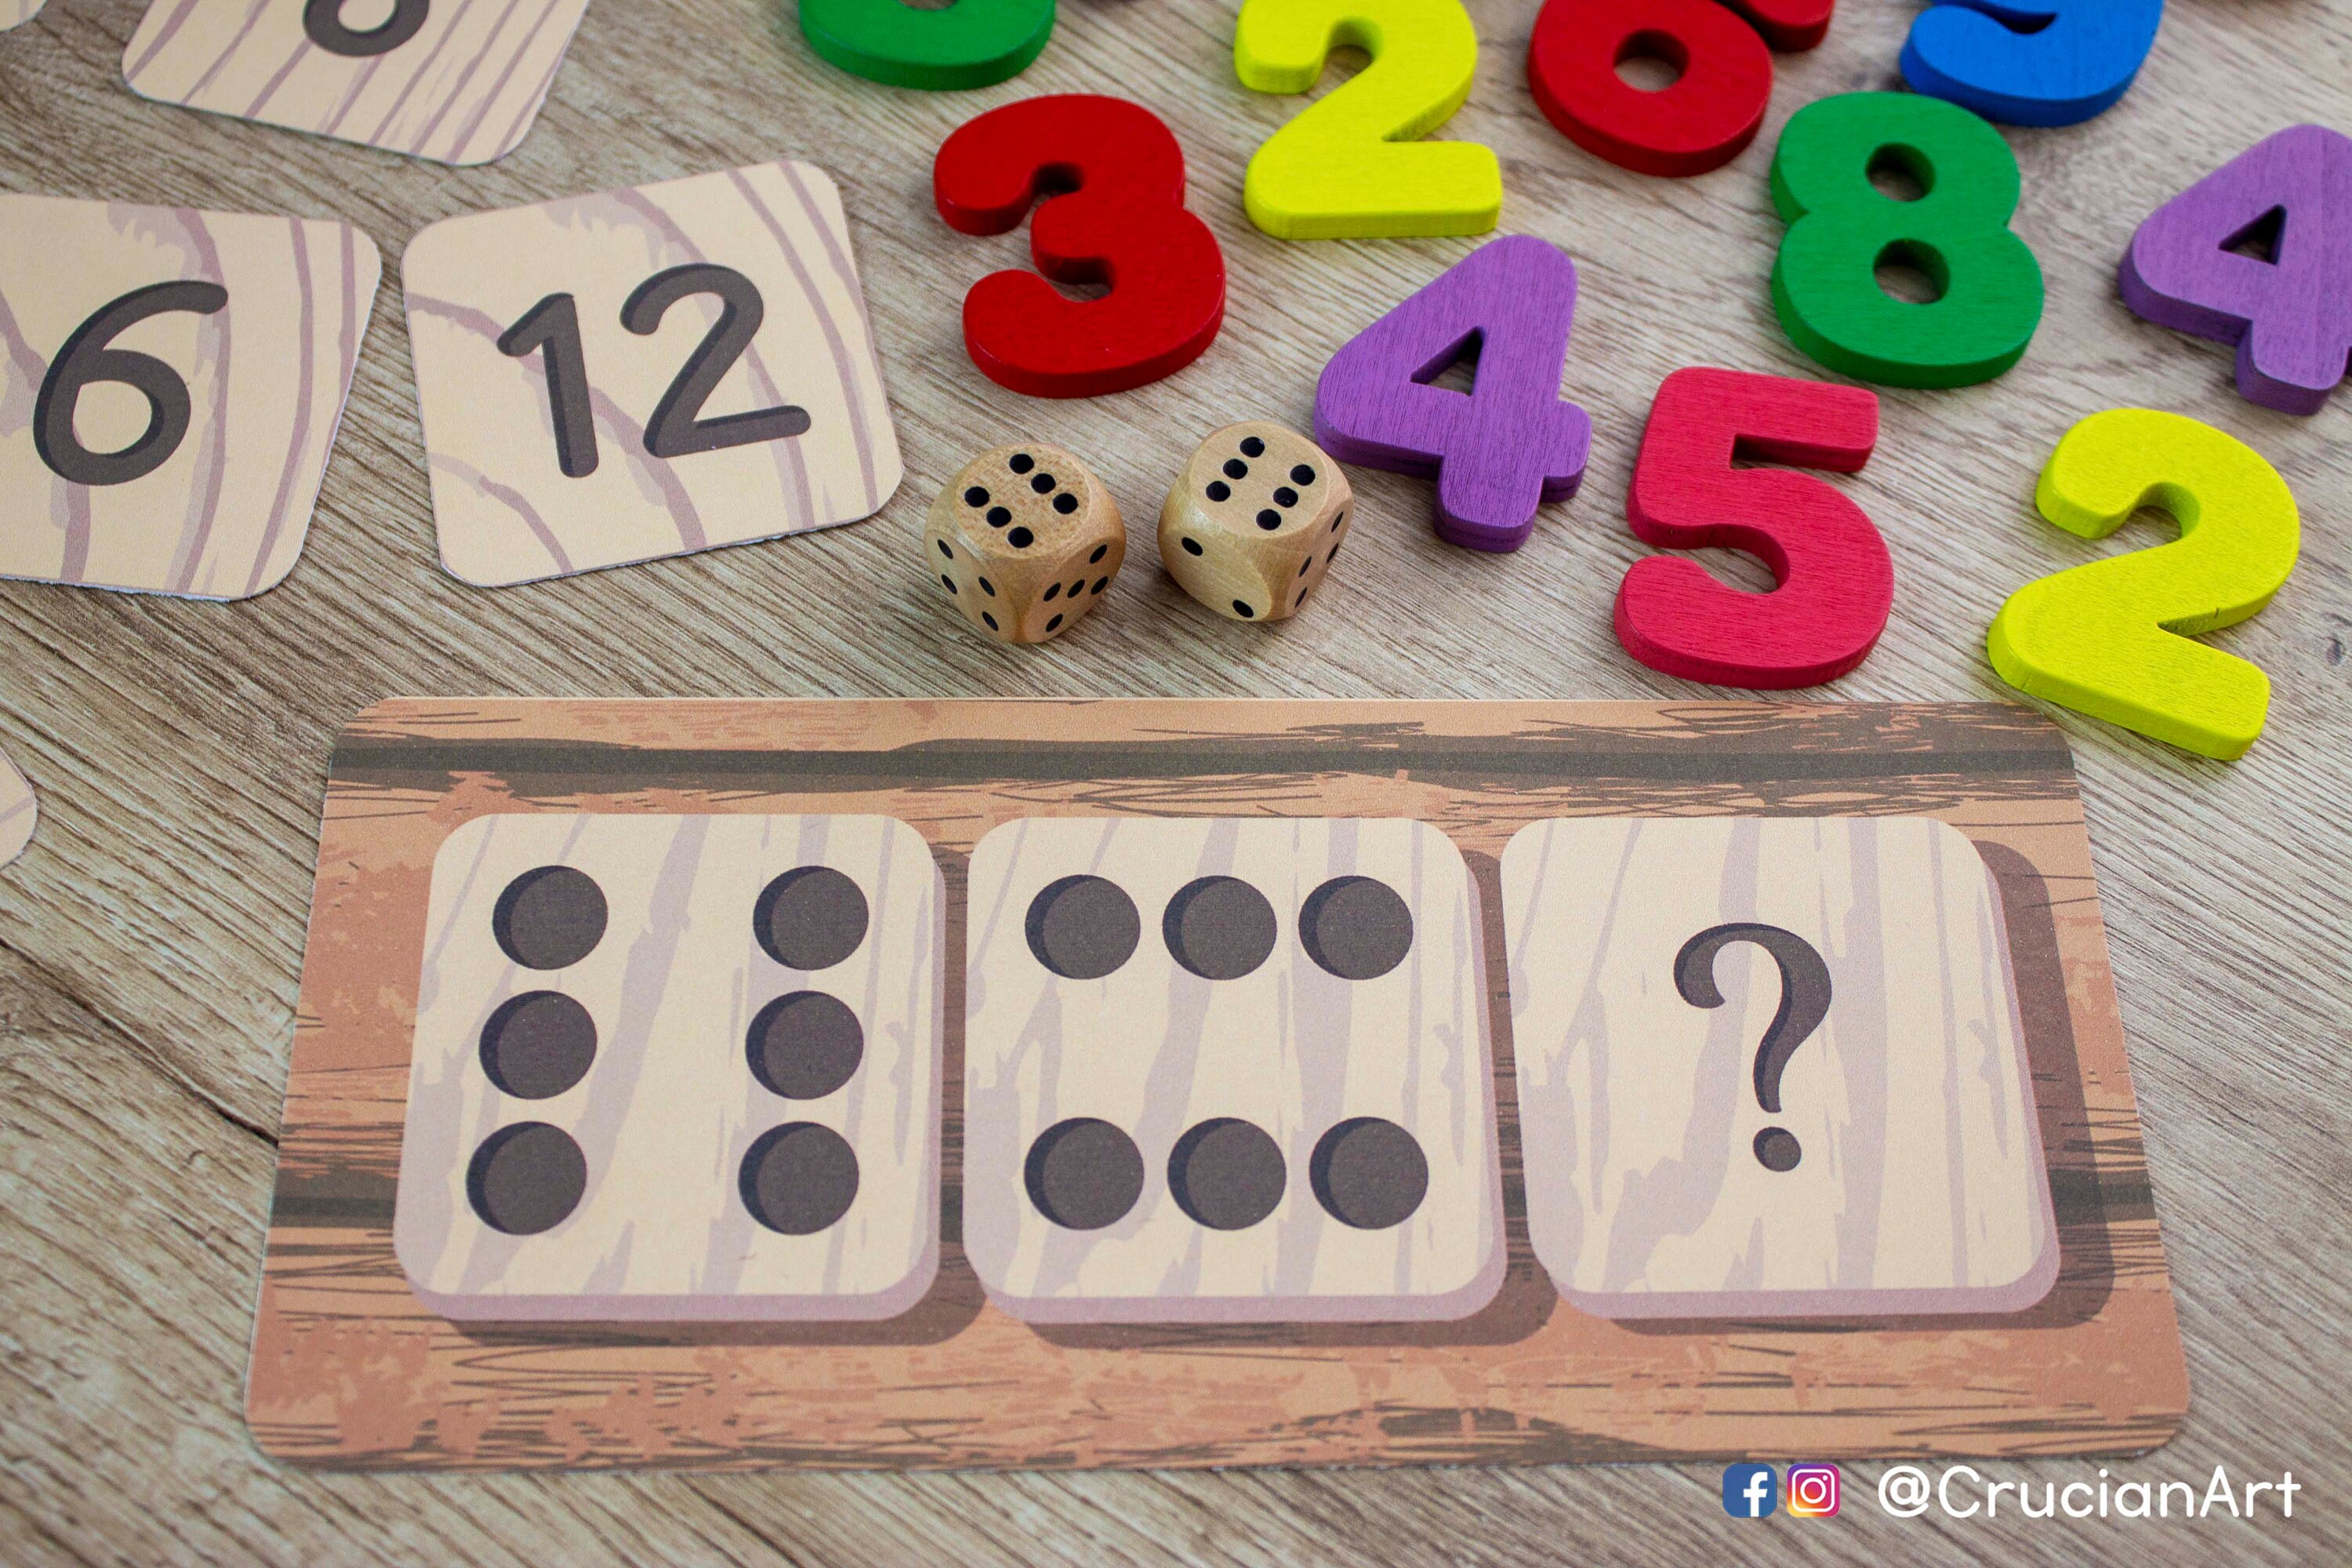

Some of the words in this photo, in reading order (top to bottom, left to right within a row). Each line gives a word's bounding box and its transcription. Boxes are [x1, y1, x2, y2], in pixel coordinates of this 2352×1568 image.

[934, 93, 1225, 397] 3
[1236, 0, 1501, 238] 2
[1771, 91, 2043, 388] 8
[33, 280, 228, 485] 6
[496, 263, 811, 477] 12
[1315, 234, 1592, 552] 4
[2119, 123, 2352, 415] 4
[1614, 366, 1893, 689] 5
[1988, 408, 2299, 760] 2
[1673, 922, 1832, 1173] ?
